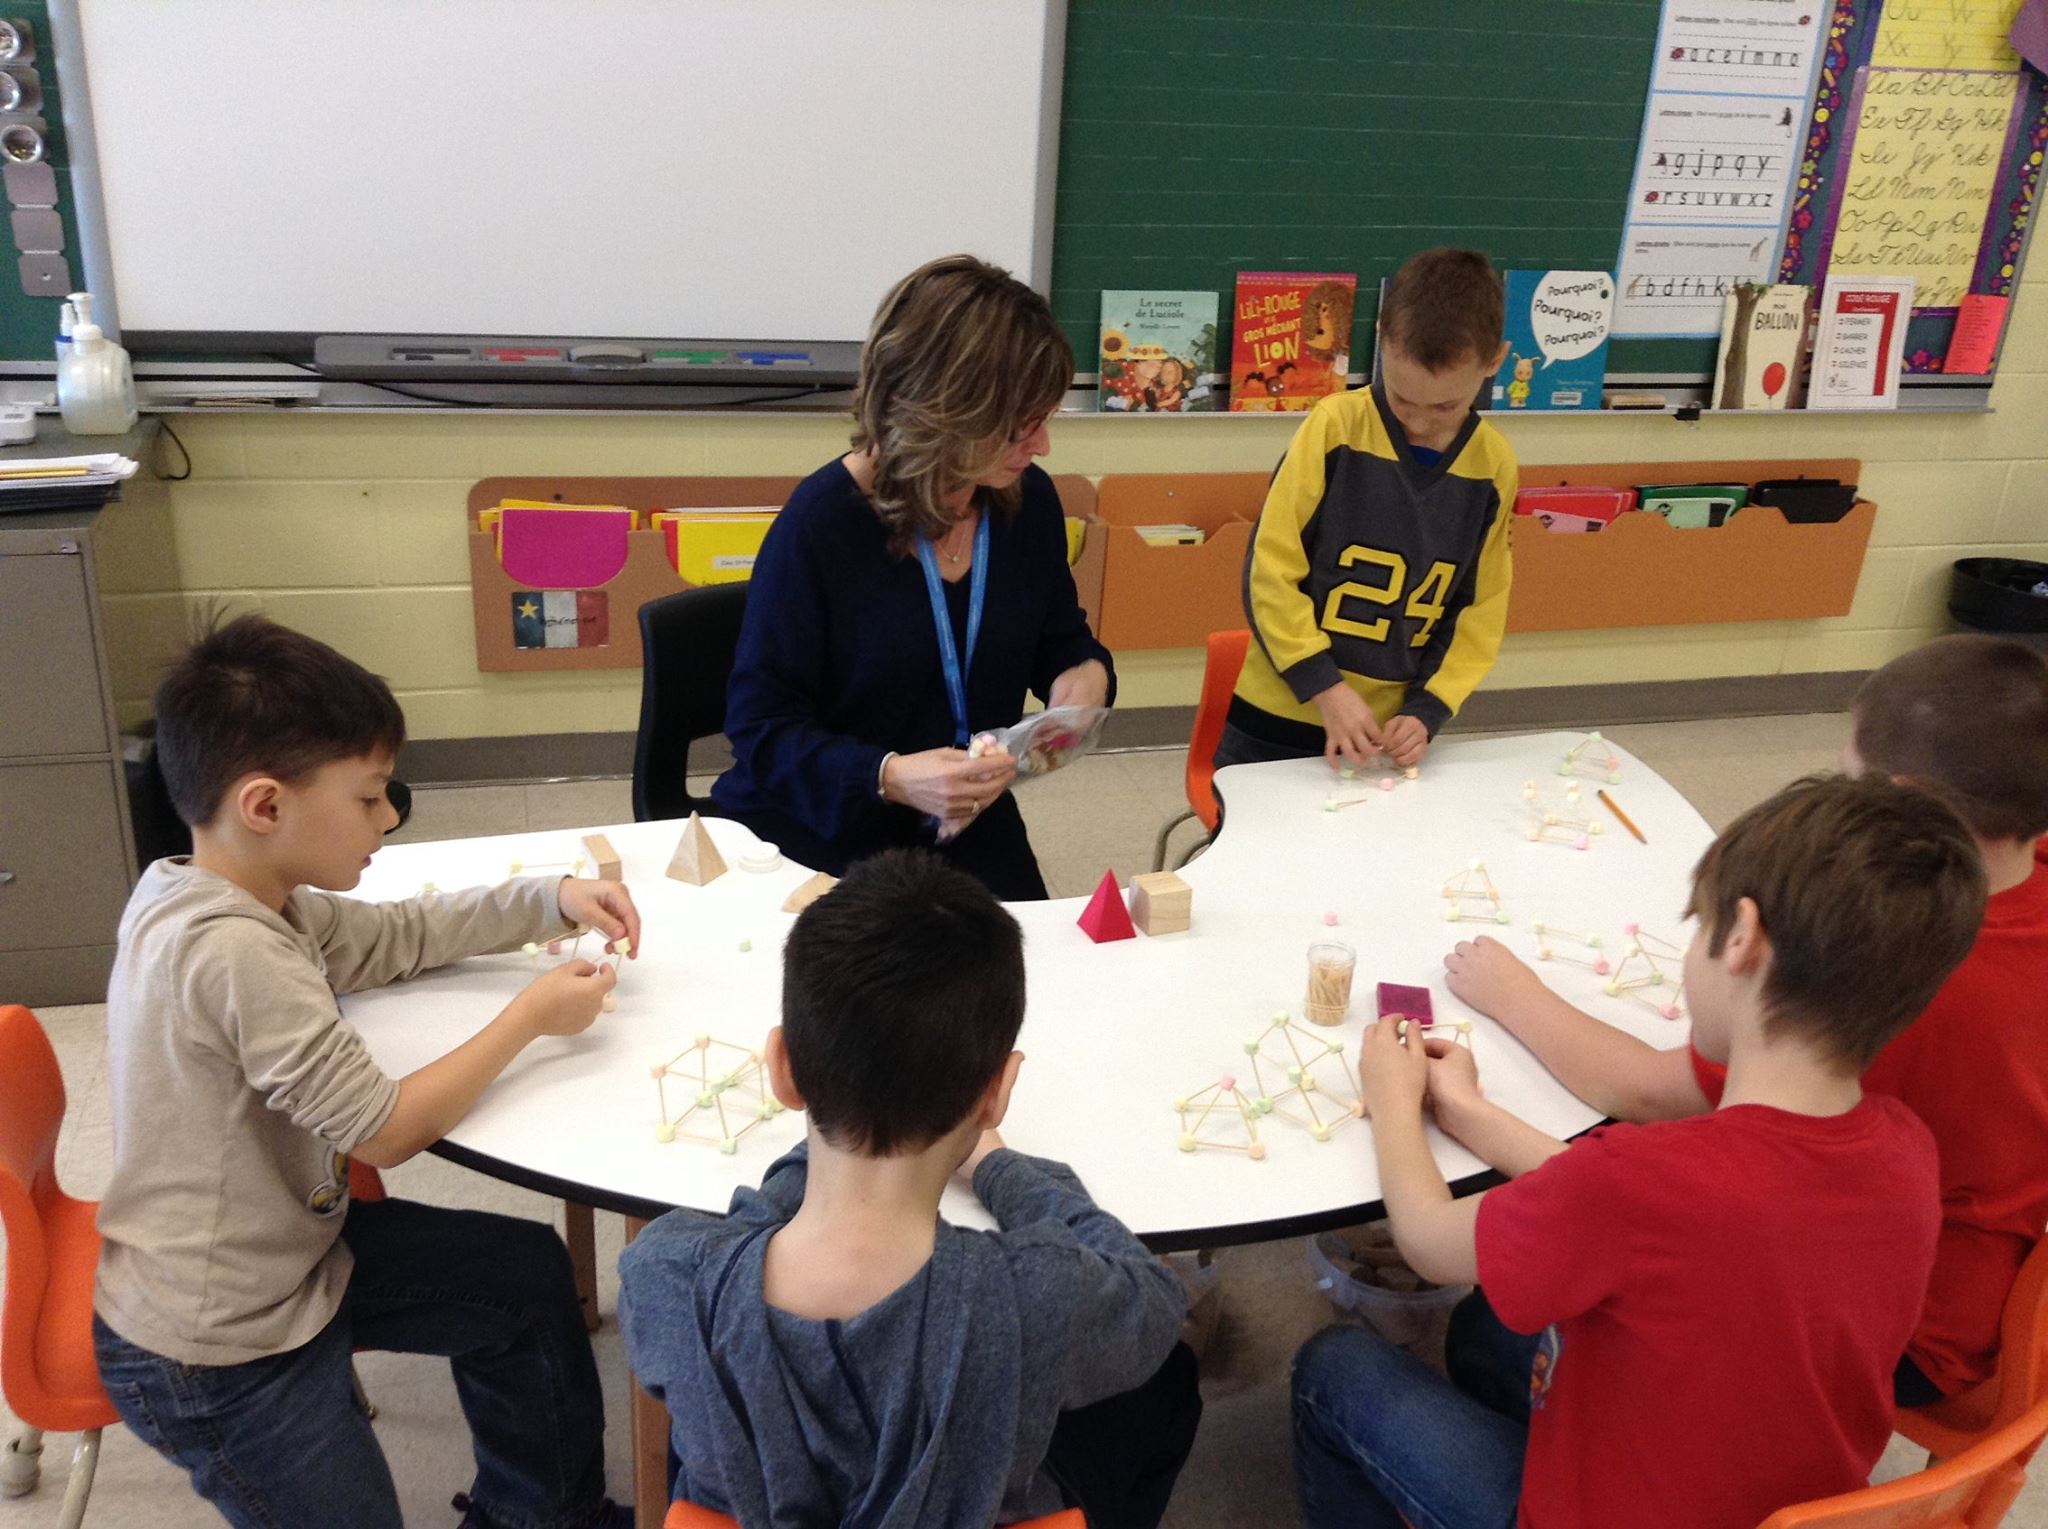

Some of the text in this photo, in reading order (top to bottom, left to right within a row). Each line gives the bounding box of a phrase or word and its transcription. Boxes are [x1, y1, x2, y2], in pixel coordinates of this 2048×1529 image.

[1548, 279, 1603, 296] Pourquoi?
[1140, 297, 1183, 308] Le secret
[1534, 299, 1602, 323] Pourquoi?
[1755, 311, 1799, 330] BALLON
[1545, 326, 1604, 345] Pourquoi?
[1320, 543, 1457, 648] 24
